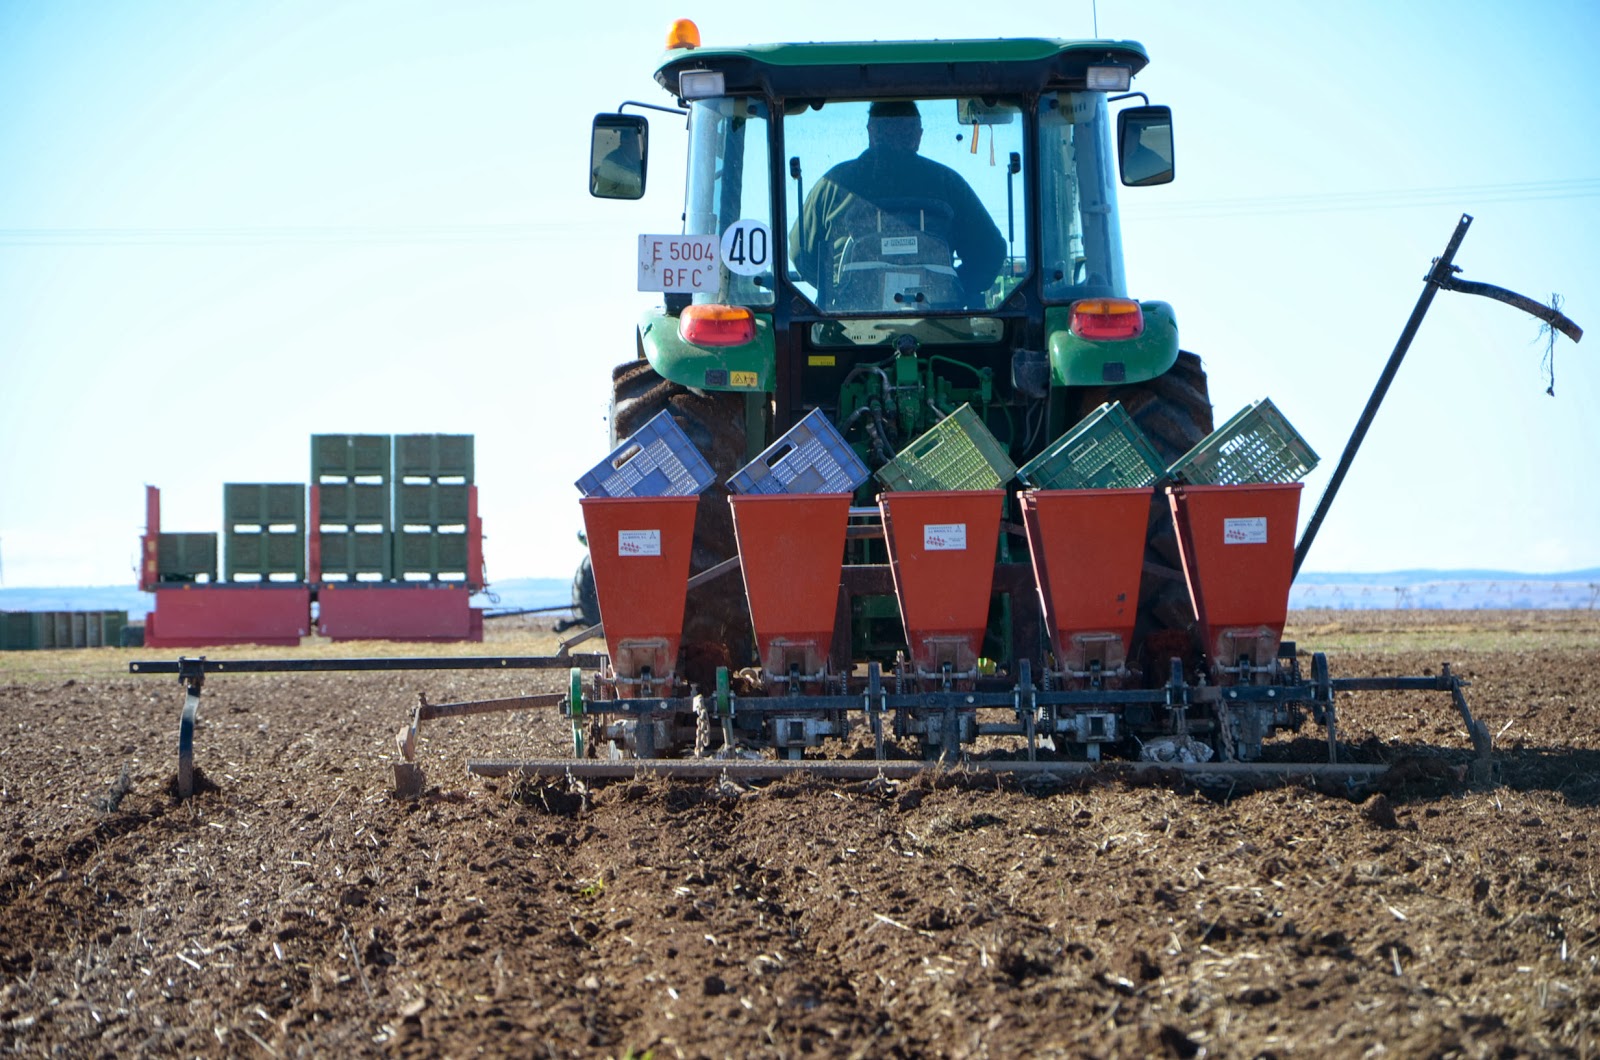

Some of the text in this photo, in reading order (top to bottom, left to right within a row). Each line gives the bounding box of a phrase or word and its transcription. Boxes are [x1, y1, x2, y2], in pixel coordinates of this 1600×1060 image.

[653, 242, 714, 261] E 5004
[729, 227, 767, 265] 40
